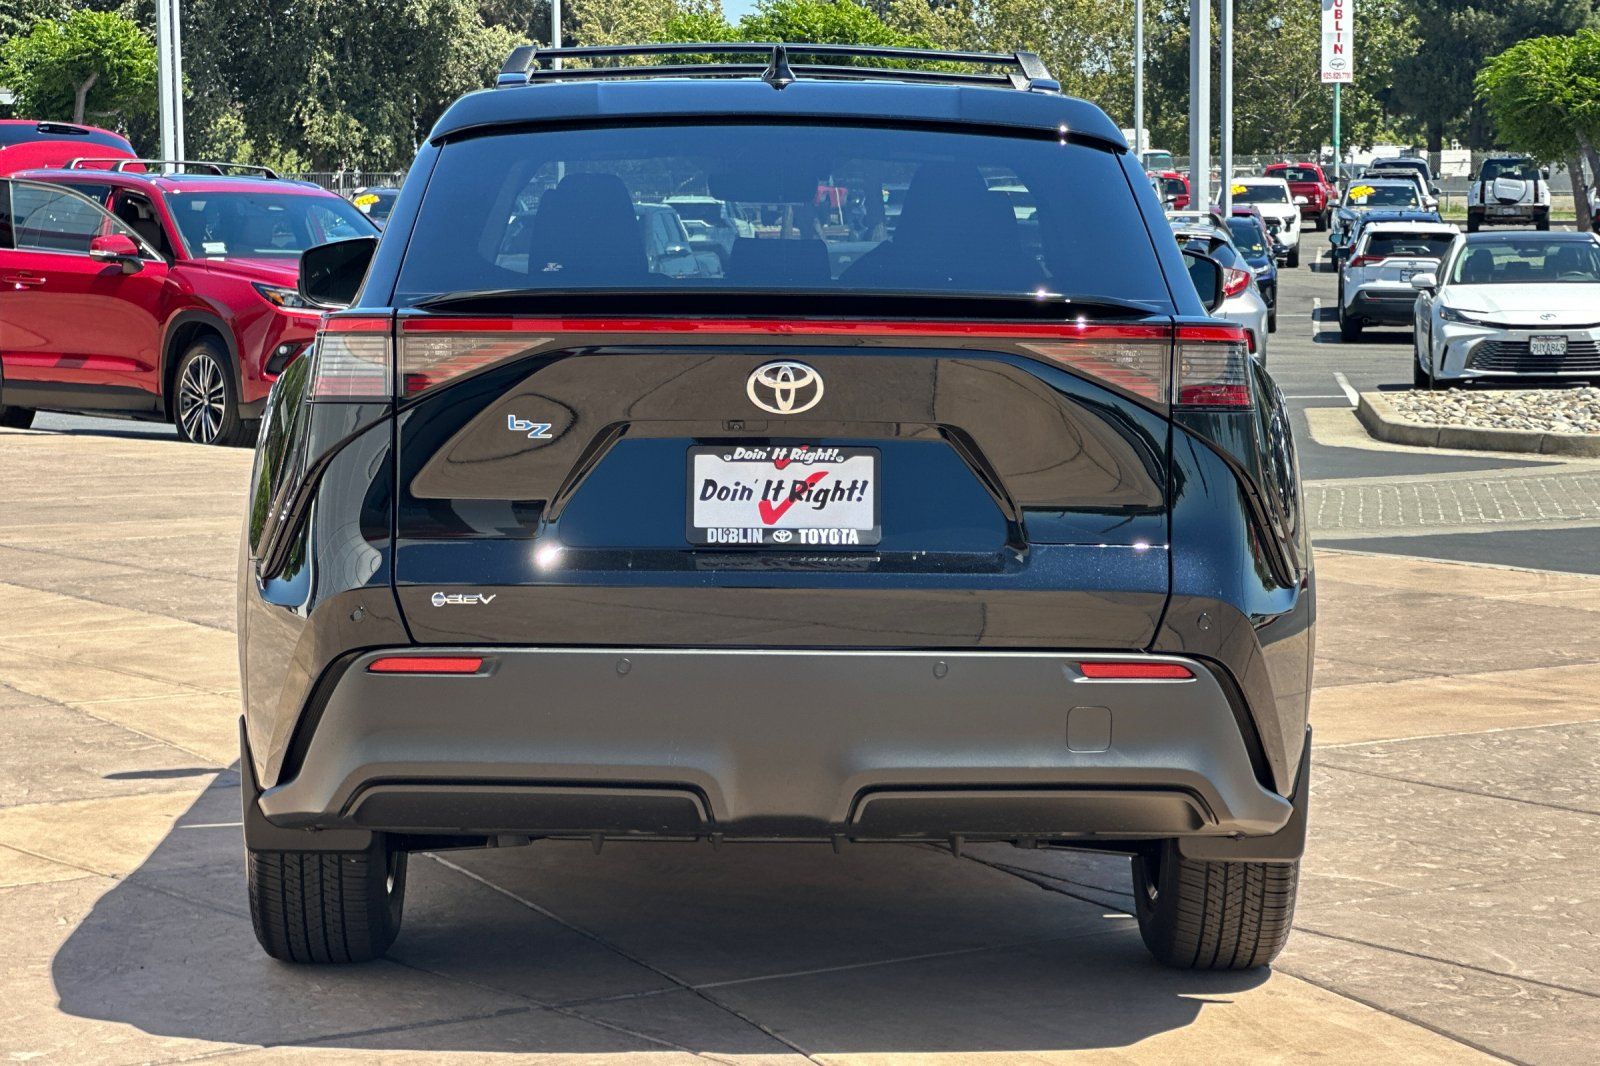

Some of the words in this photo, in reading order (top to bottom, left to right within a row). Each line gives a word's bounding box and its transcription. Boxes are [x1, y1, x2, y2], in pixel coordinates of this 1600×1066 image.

[732, 446, 771, 460] Doin'
[771, 447, 788, 460] It
[789, 447, 840, 464] Right!
[699, 478, 759, 501] Doin'
[761, 479, 785, 502] It
[789, 480, 869, 510] Right!
[707, 528, 763, 544] DUBLIN
[798, 529, 859, 545] TOYOTA
